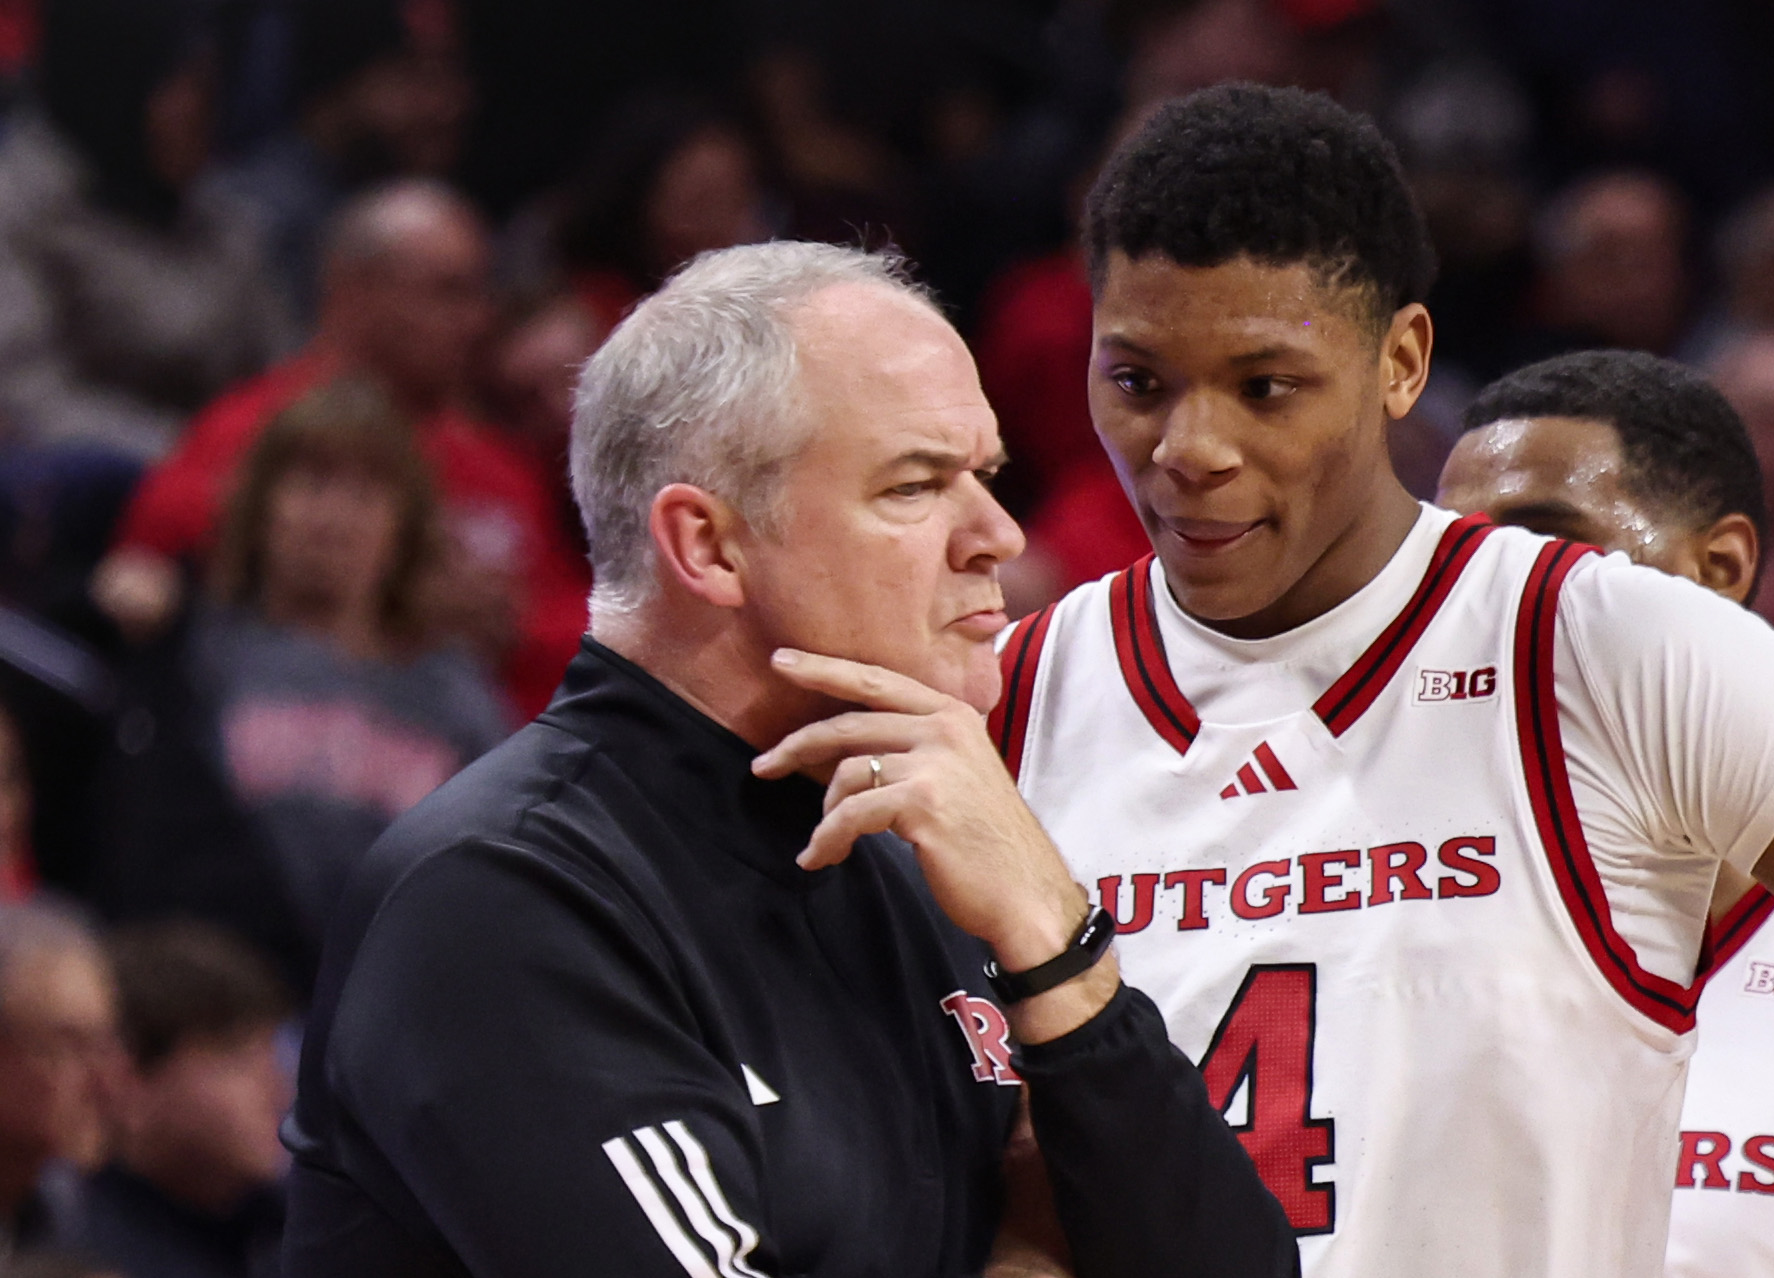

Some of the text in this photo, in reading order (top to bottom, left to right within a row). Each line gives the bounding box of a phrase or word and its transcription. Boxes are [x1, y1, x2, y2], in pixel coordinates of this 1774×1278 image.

[1097, 835, 1501, 935] UTGERS
[940, 989, 1022, 1086] R
[1197, 962, 1335, 1237] 4
